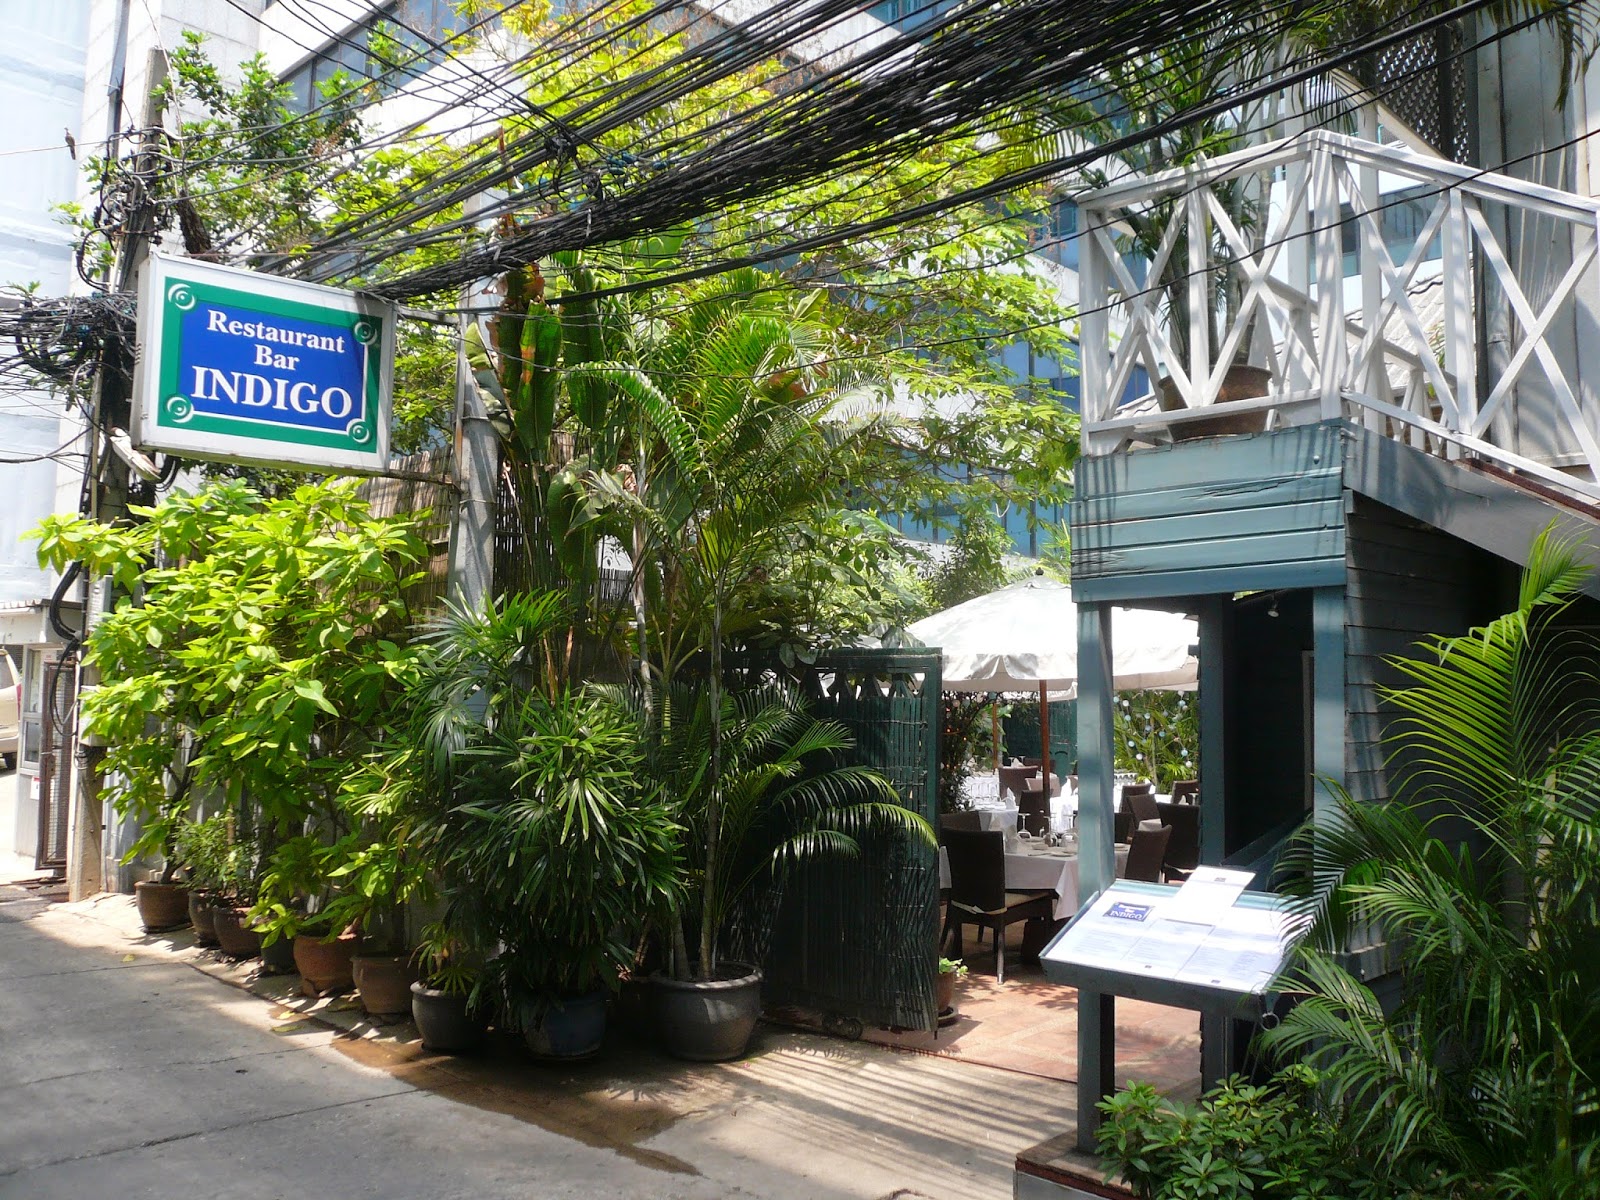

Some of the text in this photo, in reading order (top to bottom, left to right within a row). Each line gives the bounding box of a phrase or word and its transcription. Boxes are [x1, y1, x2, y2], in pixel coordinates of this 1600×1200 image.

[207, 309, 345, 353] Restaurant
[253, 344, 300, 371] Bar
[191, 366, 352, 418] INDIGO
